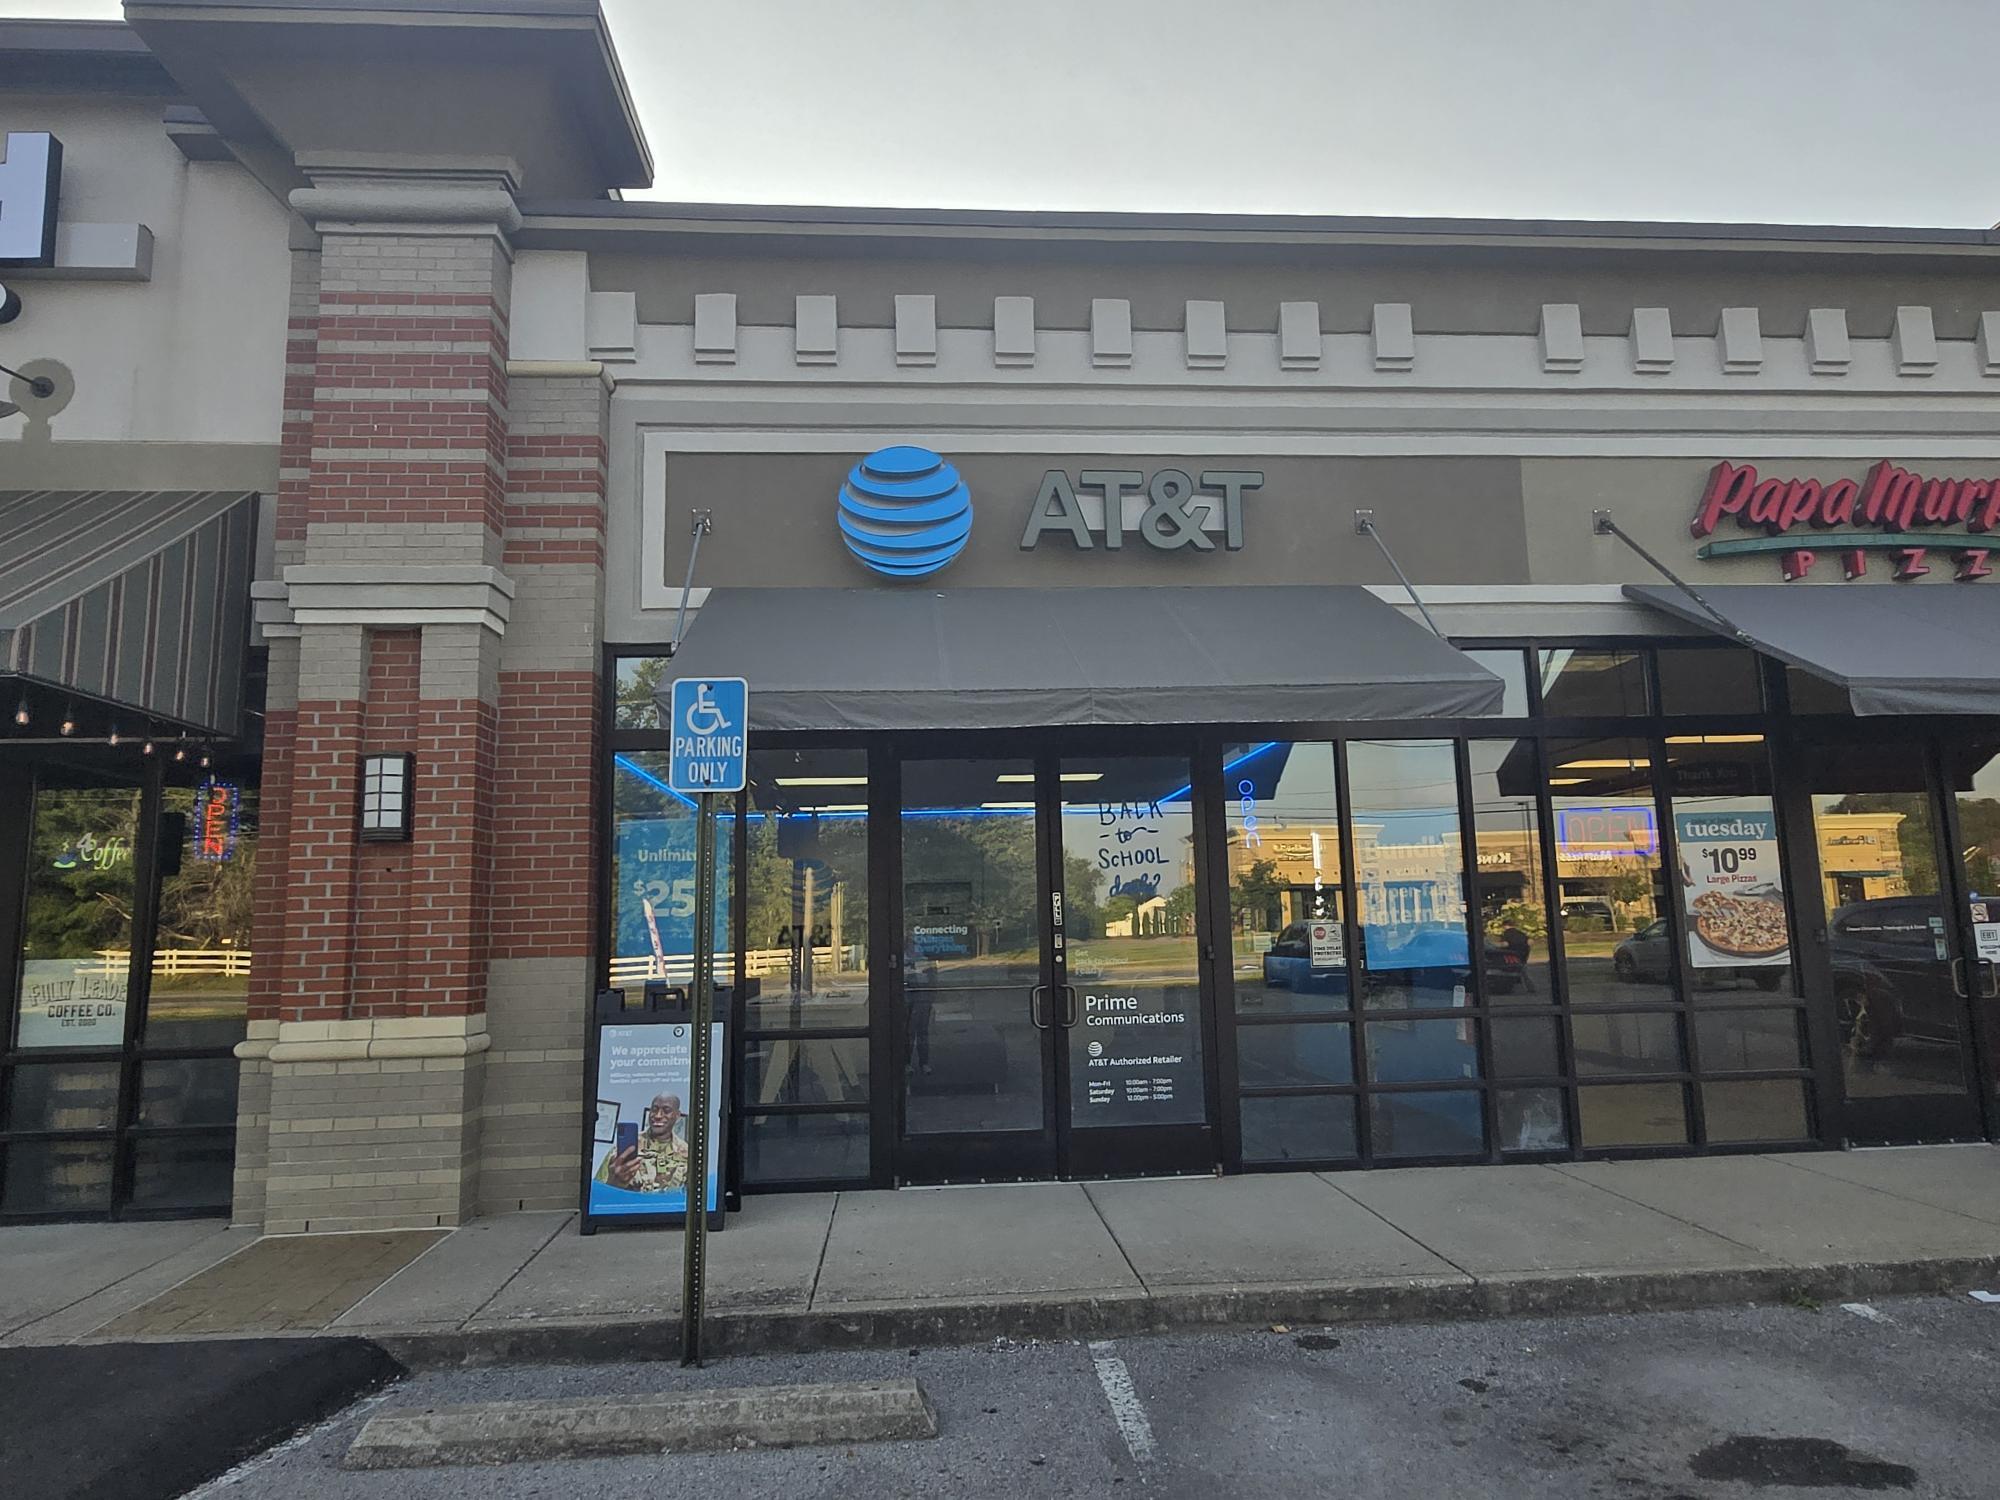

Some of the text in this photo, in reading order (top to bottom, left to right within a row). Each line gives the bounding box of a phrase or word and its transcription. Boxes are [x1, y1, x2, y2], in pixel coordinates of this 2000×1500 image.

[1690, 460, 1860, 538] Papa
[1019, 469, 1264, 552] AT&T
[675, 736, 742, 758] PARKING
[688, 762, 728, 783] ONLY
[203, 787, 227, 855] OPEN
[1238, 780, 1261, 848] open
[1115, 828, 1133, 843] to
[1567, 815, 1648, 847] OPEN
[1685, 819, 1768, 839] tuesday
[80, 836, 131, 870] Coffee
[1707, 874, 1758, 885] Large Pizzas
[913, 924, 968, 935] Connecting
[28, 981, 75, 1007] FULLY
[1085, 994, 1138, 1011] Prime
[47, 1004, 116, 1018] COFFEE CO.
[1086, 1012, 1185, 1026] Communications
[611, 1044, 688, 1057] We appreciate
[610, 1058, 636, 1071] your
[1088, 1055, 1182, 1067] AT&T Authorized Retailer
